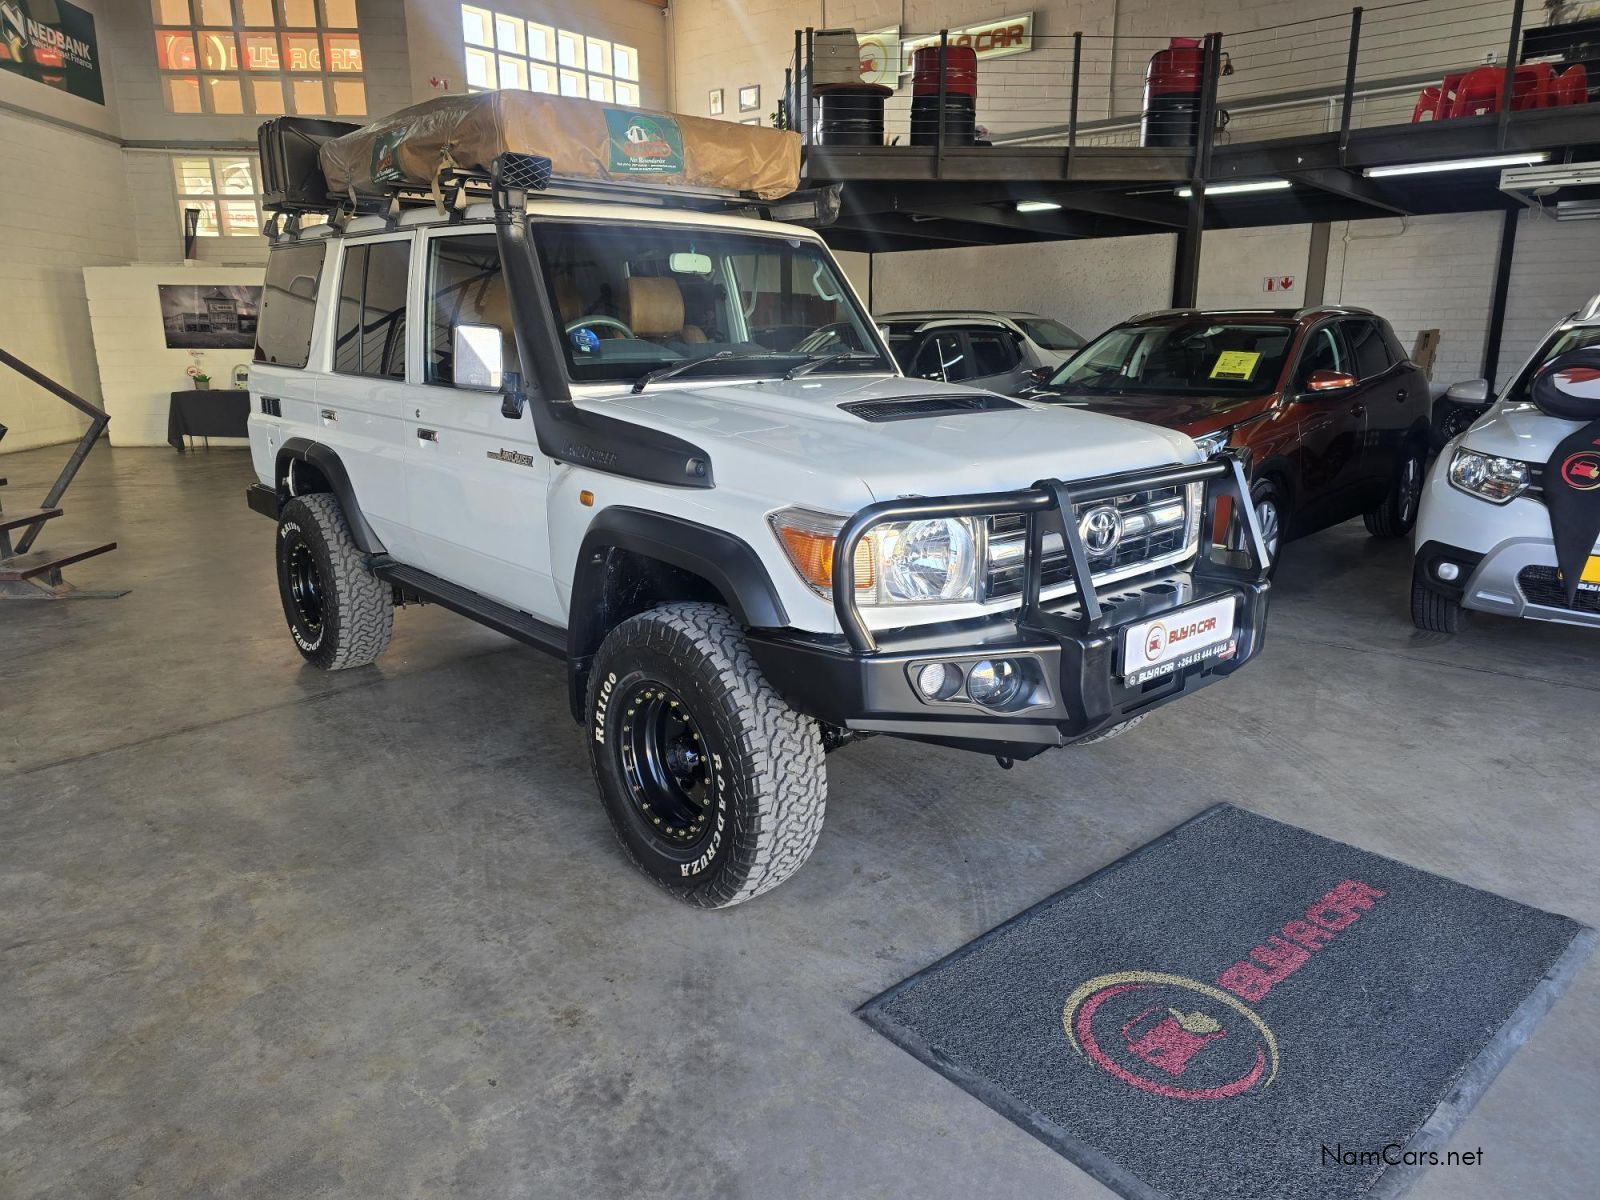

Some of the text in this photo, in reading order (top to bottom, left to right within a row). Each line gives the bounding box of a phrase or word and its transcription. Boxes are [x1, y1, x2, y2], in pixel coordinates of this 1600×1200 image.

[27, 17, 91, 60] NEDBANK
[975, 24, 1024, 52] CAR
[1168, 617, 1217, 645] BUY A CAR
[1138, 667, 1154, 684] BUY
[1154, 667, 1160, 678] A
[1160, 661, 1175, 675] CAR
[1177, 655, 1193, 668] +264
[1201, 648, 1213, 659] 444
[680, 752, 727, 877] ROADCRUZA
